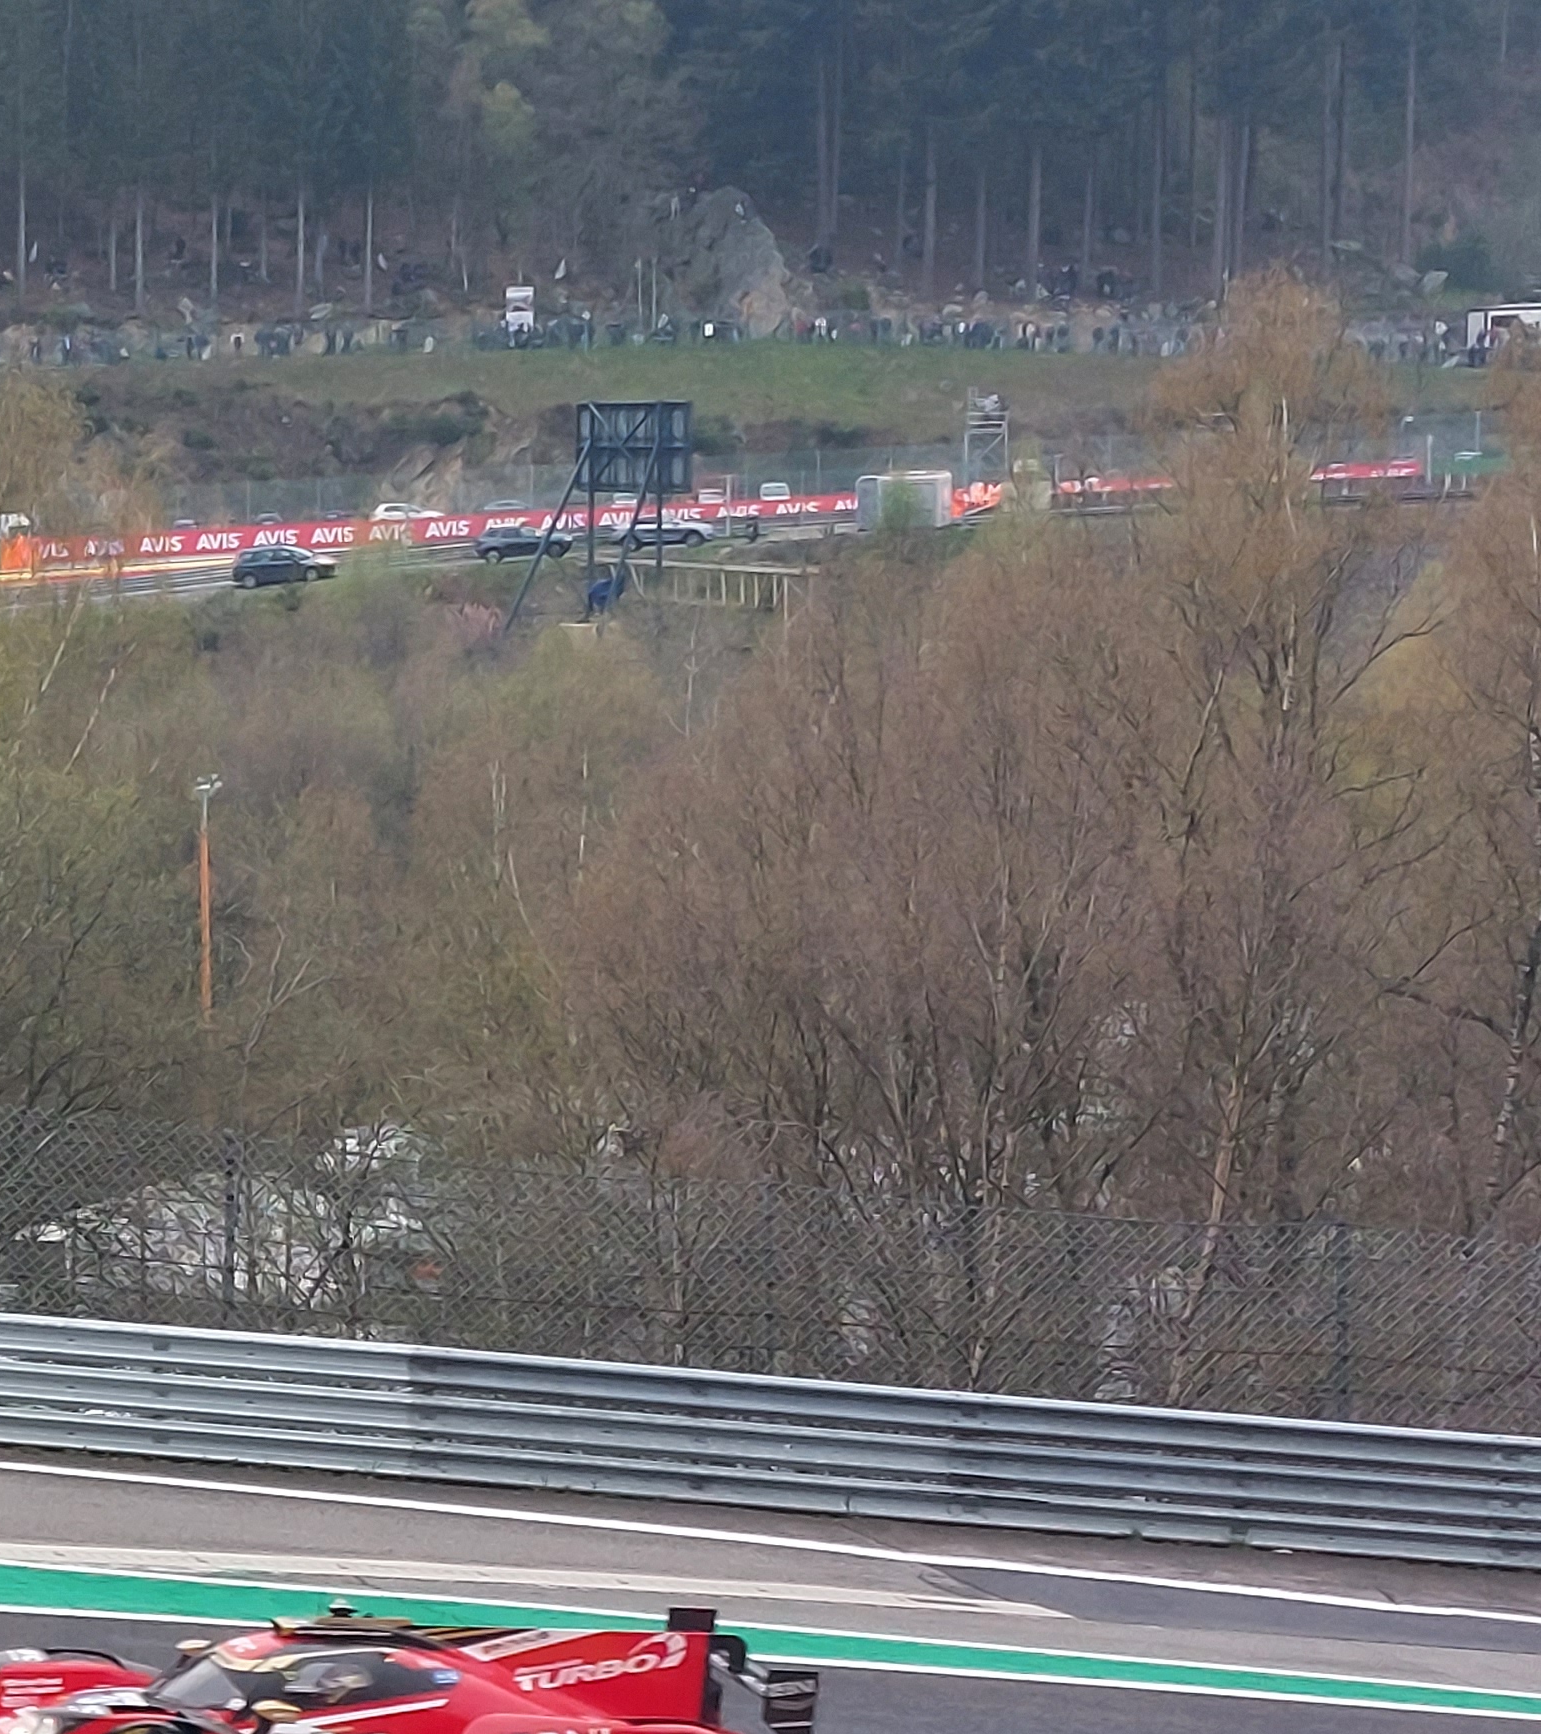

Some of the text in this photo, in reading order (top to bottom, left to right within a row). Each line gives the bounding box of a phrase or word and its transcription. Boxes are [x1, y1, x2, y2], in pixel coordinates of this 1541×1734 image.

[139, 535, 185, 554] AVIS
[195, 532, 243, 550] AVIS
[252, 529, 300, 546] AVIS
[310, 526, 357, 545] AVIS
[424, 520, 471, 538] AVIS
[513, 1652, 663, 1692] TURBO
